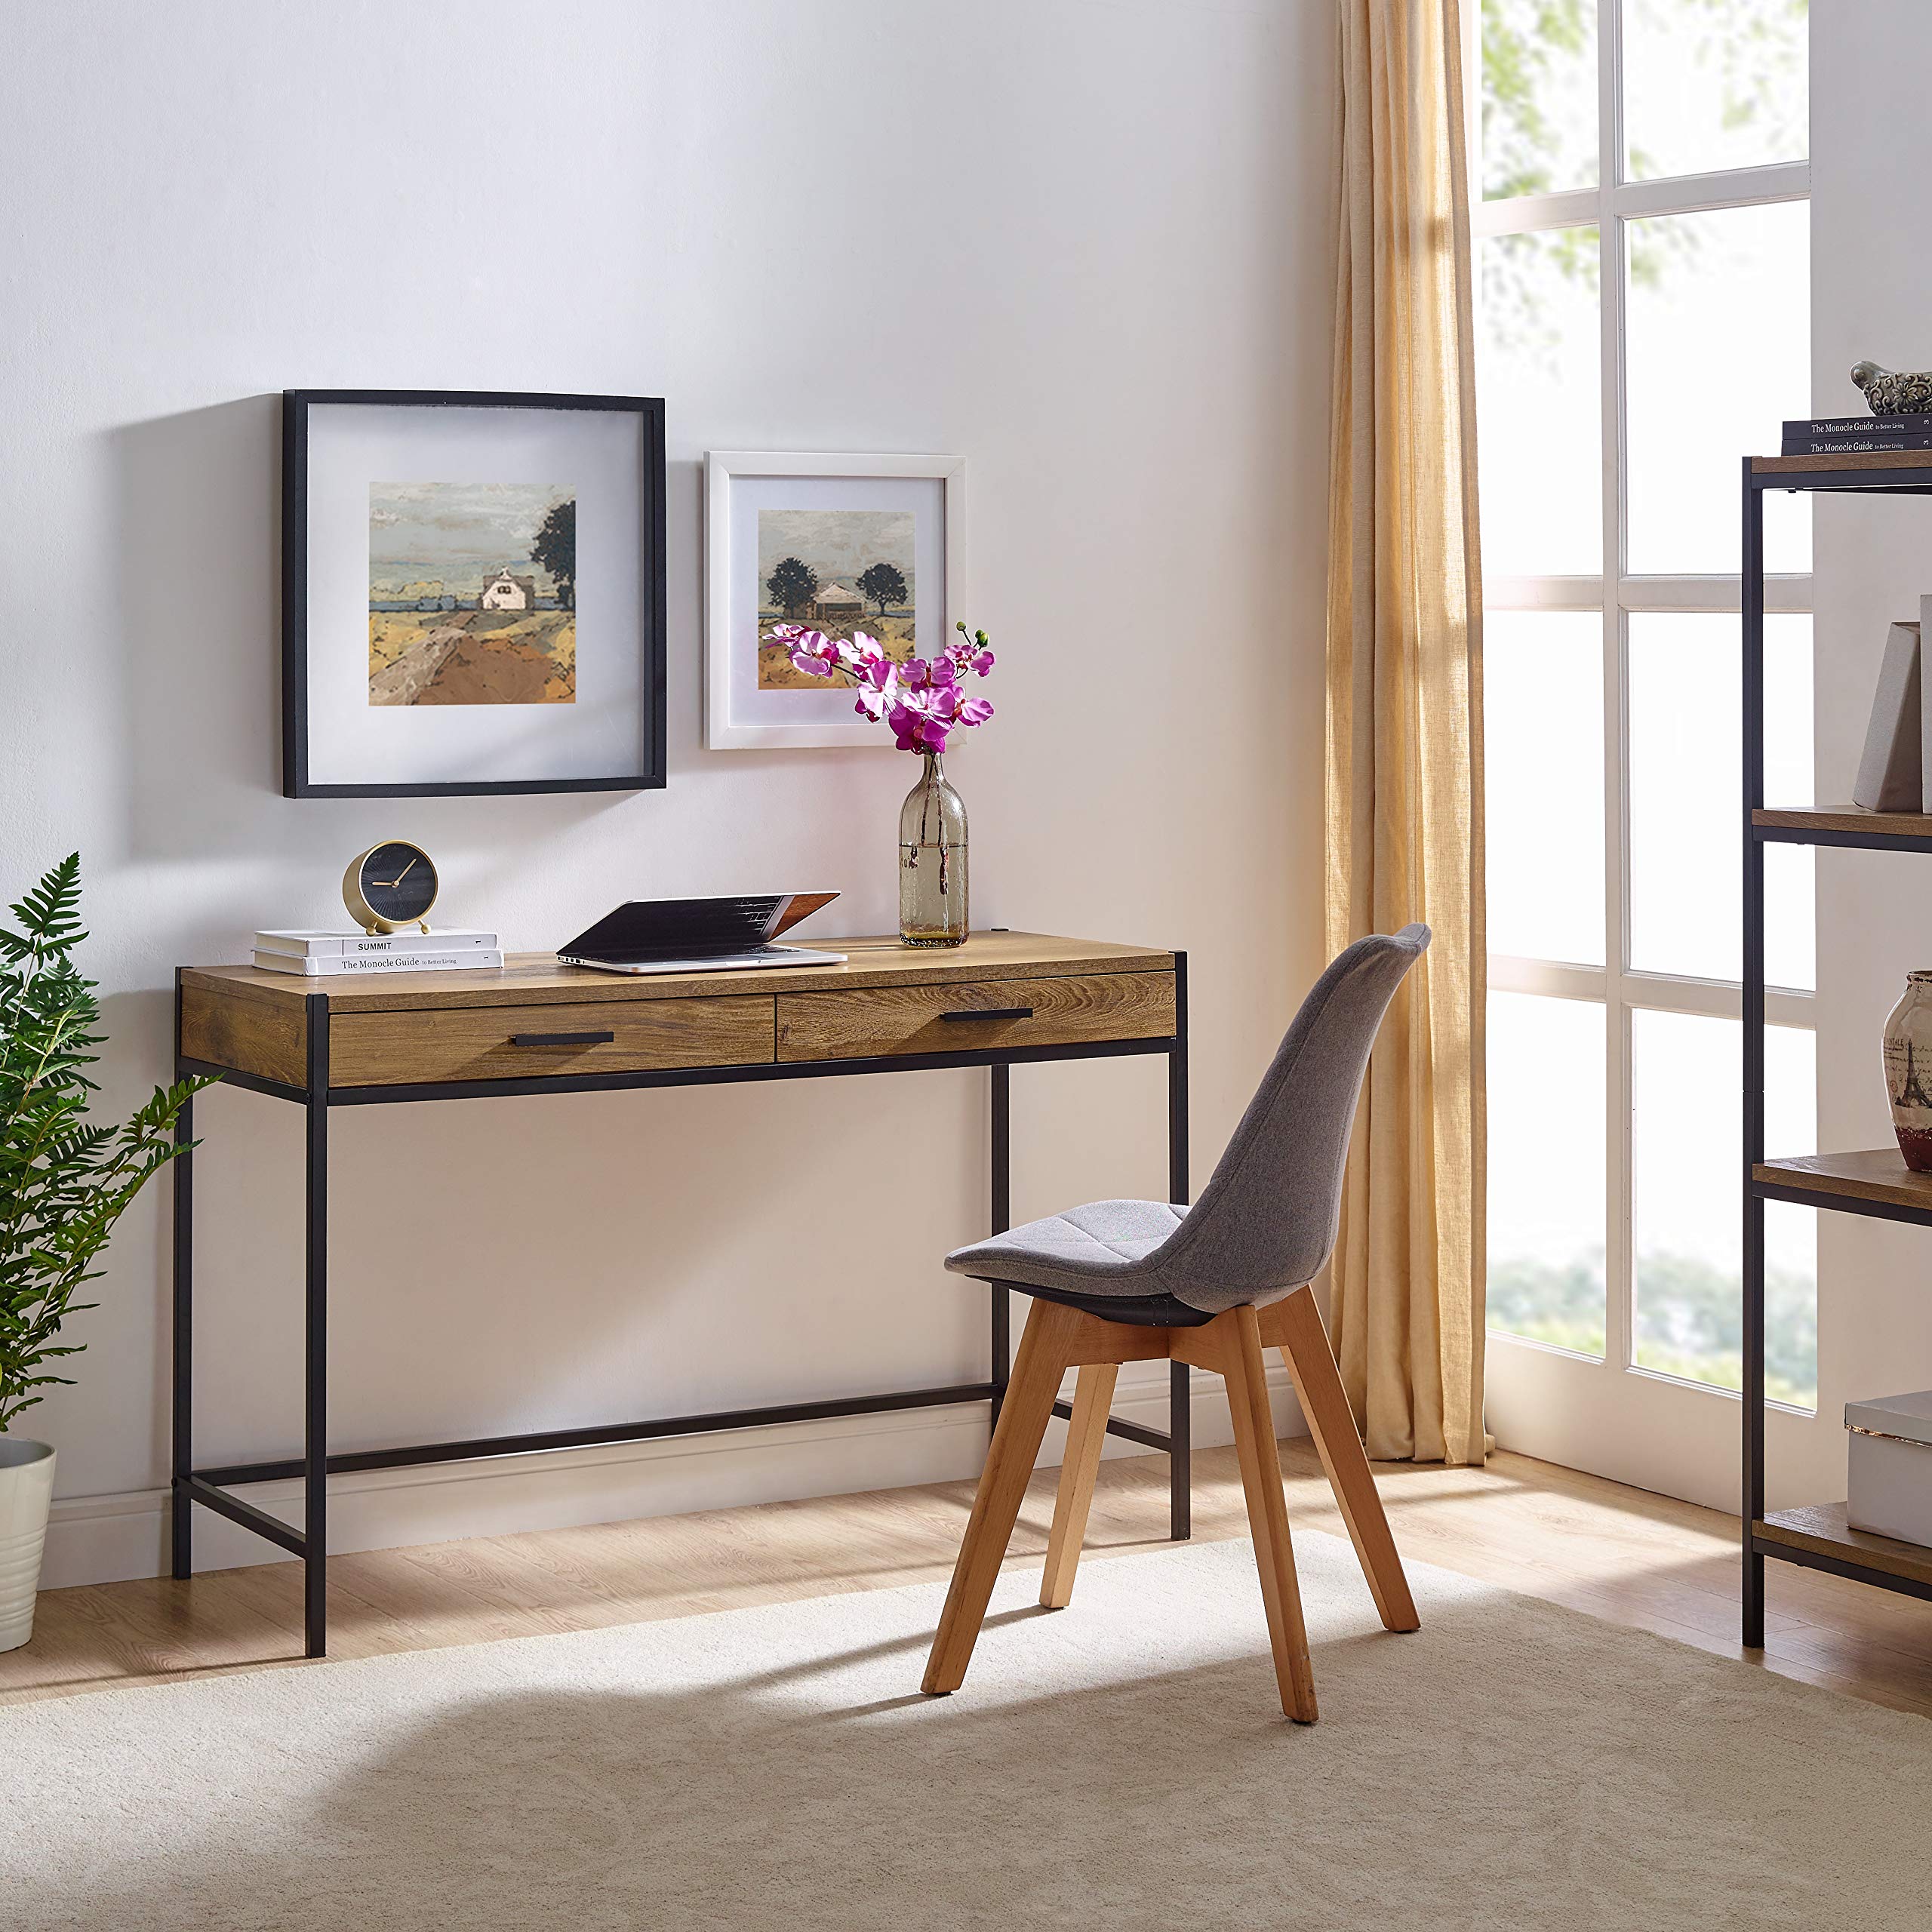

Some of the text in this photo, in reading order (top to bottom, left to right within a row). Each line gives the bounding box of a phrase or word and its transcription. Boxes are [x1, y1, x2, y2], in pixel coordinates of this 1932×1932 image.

[1811, 423, 1824, 433] The
[1825, 422, 1854, 432] Monocle
[1854, 421, 1874, 431] Guide
[1810, 443, 1823, 453] The
[1823, 441, 1853, 452] Monocle
[1853, 441, 1873, 451] Guide
[358, 942, 392, 951] SUMMIT
[341, 960, 358, 969] The
[359, 958, 394, 968] Monocle
[395, 957, 420, 967] Guide
